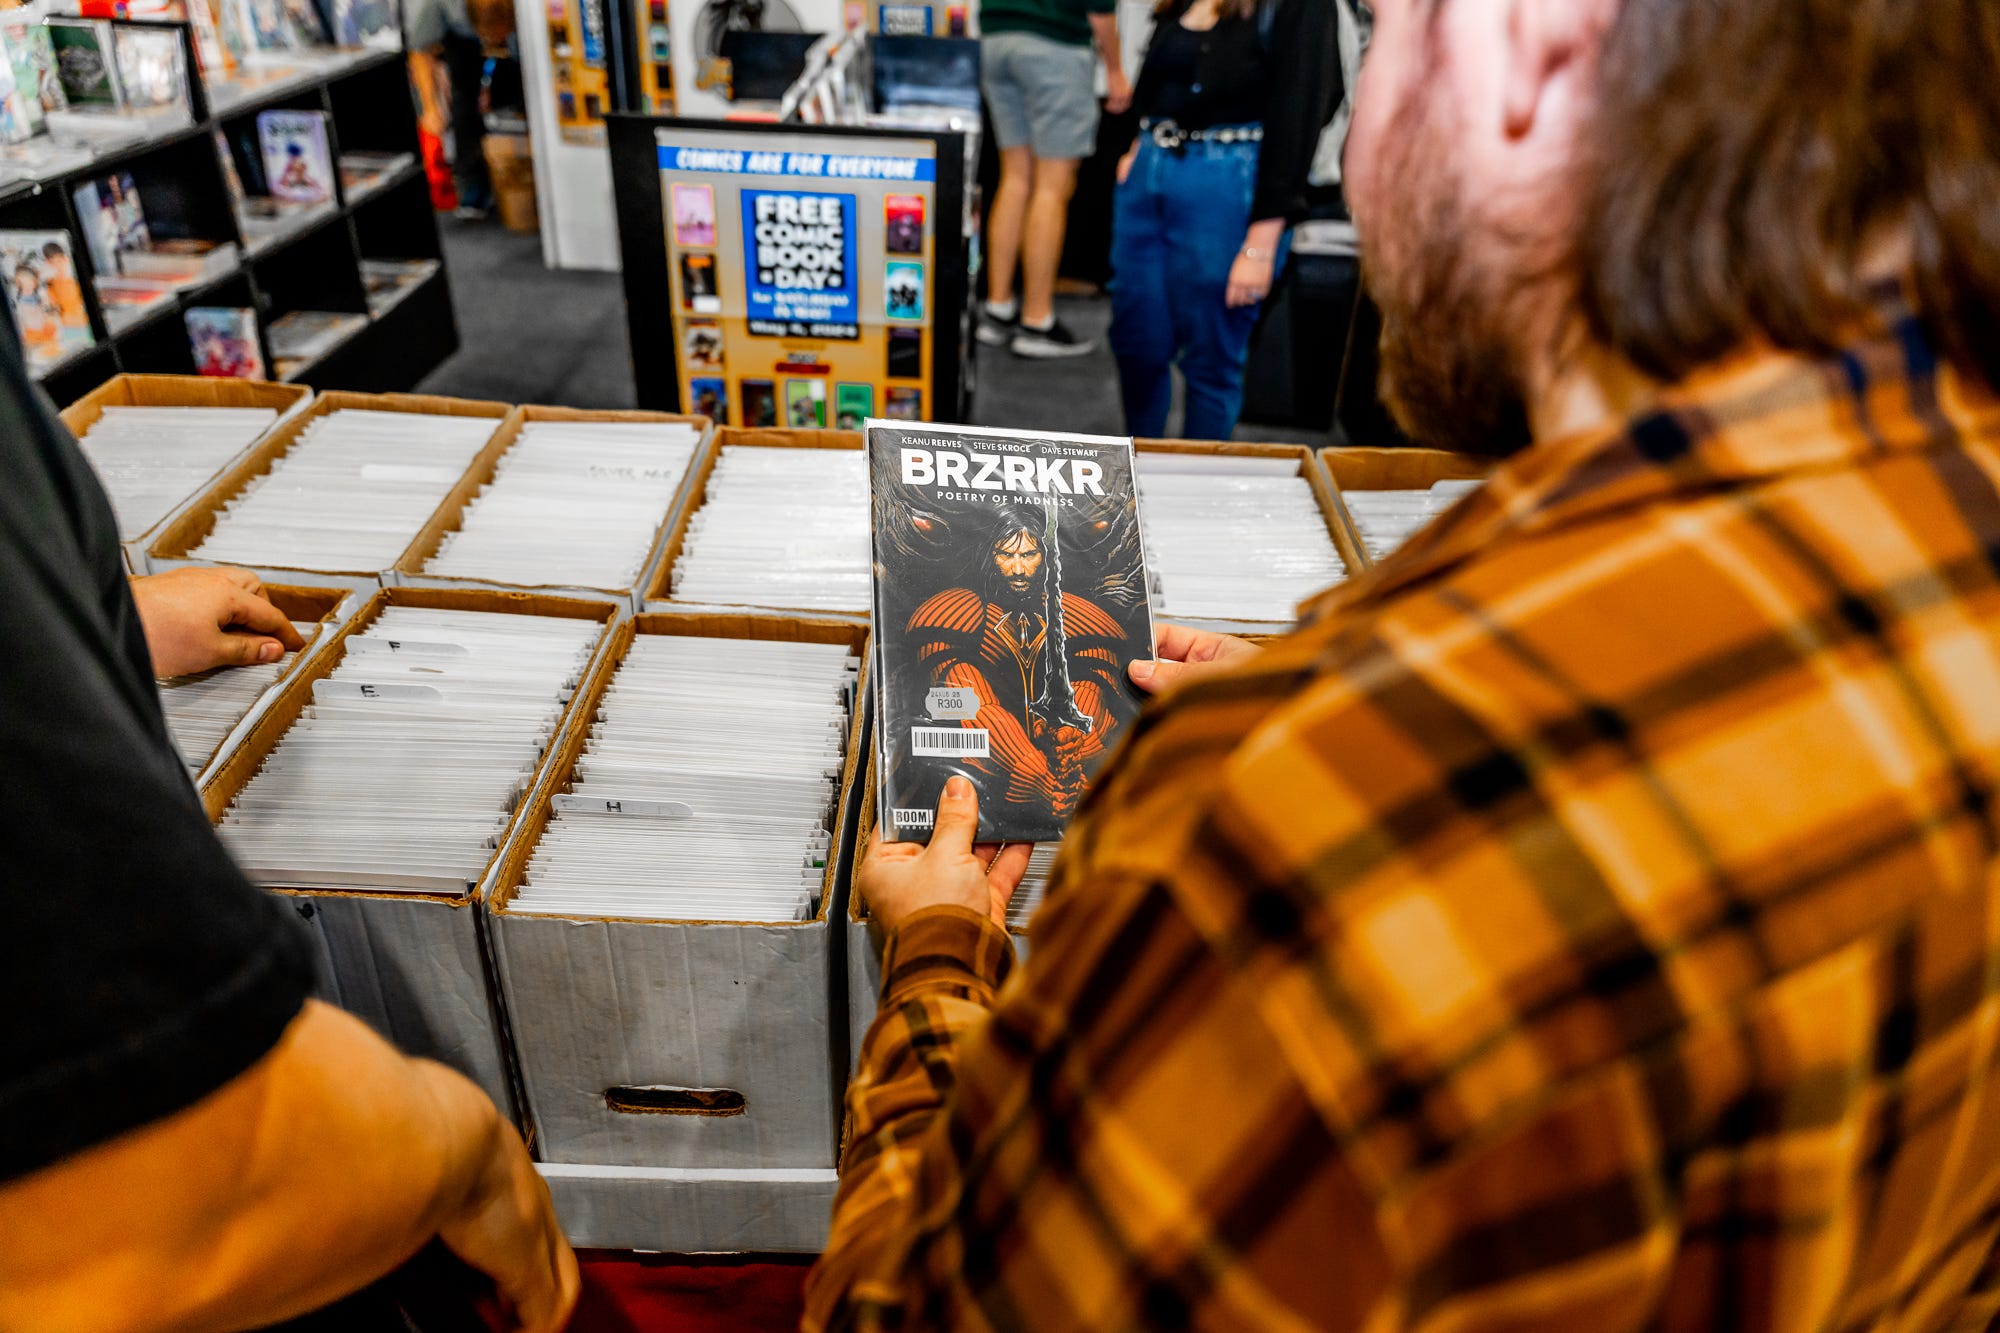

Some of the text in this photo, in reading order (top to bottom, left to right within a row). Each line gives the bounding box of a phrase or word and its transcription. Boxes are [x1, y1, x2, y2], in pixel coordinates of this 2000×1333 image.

[676, 149, 918, 179] COMICS ARE FOR EVERYONE
[755, 195, 841, 226] FREE
[755, 222, 843, 249] COMIC
[757, 245, 843, 272] BOOK
[774, 268, 829, 290] DAY
[901, 436, 1099, 457] KEANU REEVES STEVE SKROCE DAVE STEWART
[900, 448, 1106, 496] BRZRKR
[937, 491, 1074, 507] POETRY OF MADNESS
[388, 640, 401, 653] F
[360, 684, 380, 698] E
[937, 699, 963, 708] R300
[606, 801, 621, 812] H
